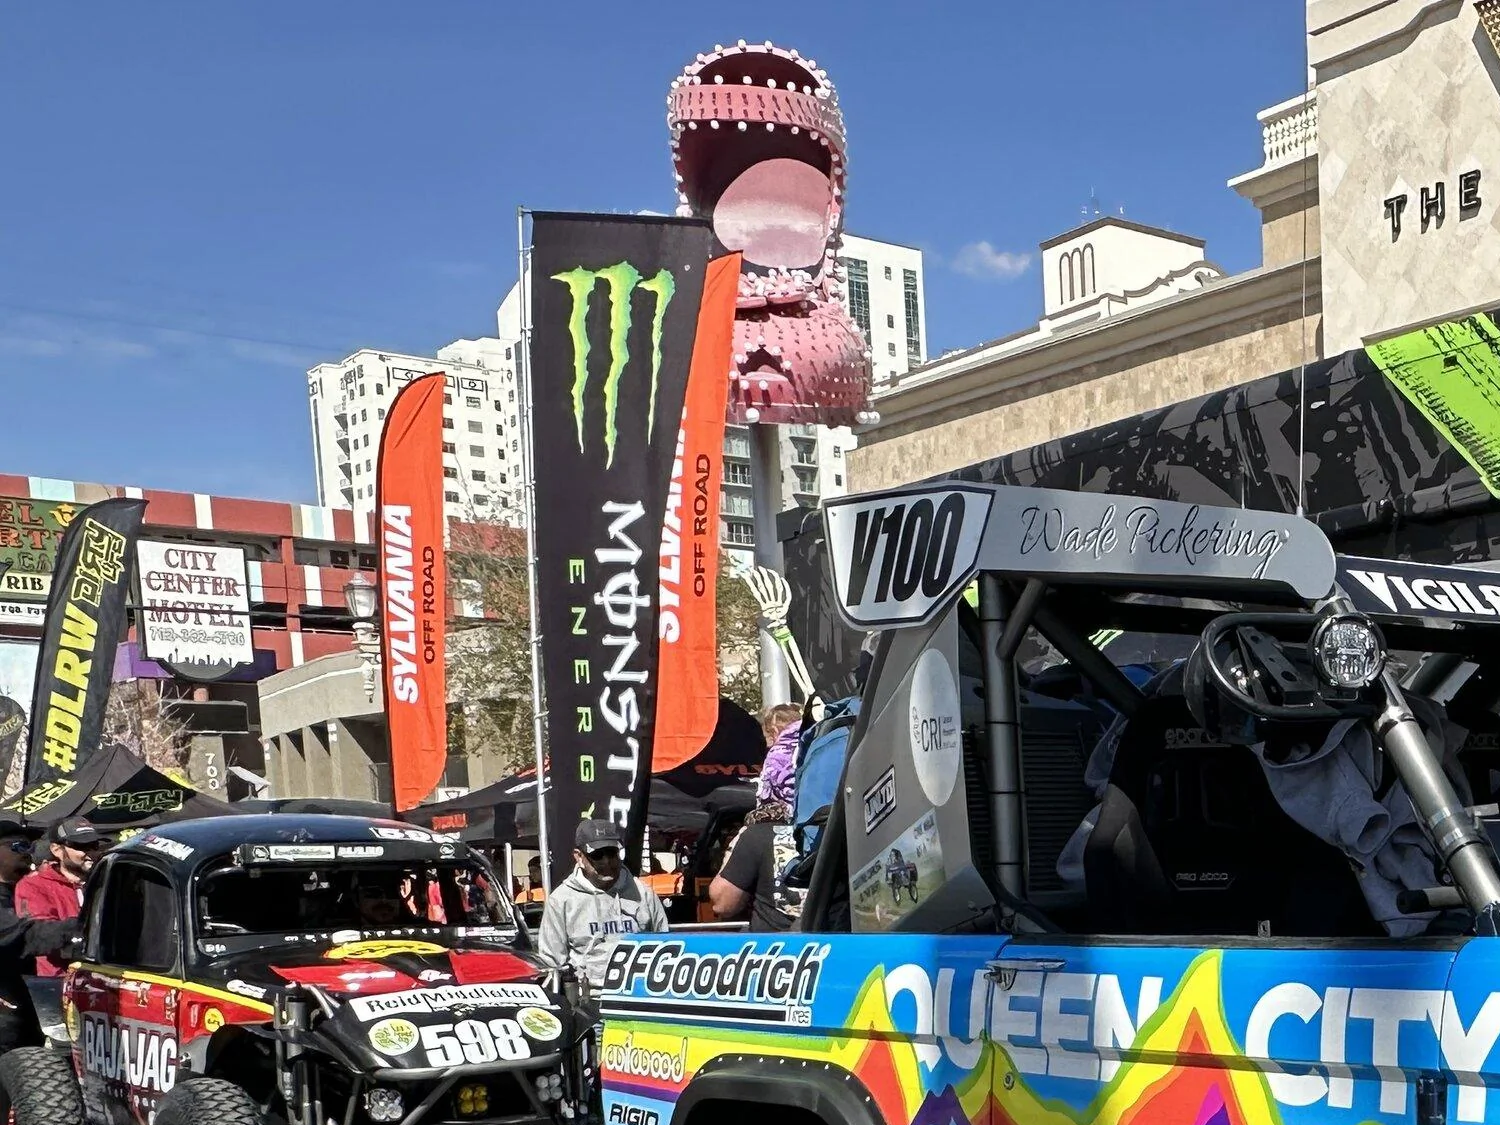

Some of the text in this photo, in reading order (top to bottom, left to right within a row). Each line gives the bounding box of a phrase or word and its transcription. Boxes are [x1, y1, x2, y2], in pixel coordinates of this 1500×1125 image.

[1384, 169, 1482, 238] THE
[164, 548, 217, 571] CITY
[693, 454, 710, 598] OFF ROAD
[846, 492, 966, 606] V100
[1020, 503, 1290, 579] Wade Pickering
[6, 576, 44, 591] RIB
[146, 571, 241, 597] CENTER
[147, 598, 244, 628] MOTEL
[383, 504, 419, 705] SYLVANIA
[423, 546, 435, 665] OFF ROAD
[43, 601, 98, 772] #DLRW
[921, 718, 943, 752] CRI
[601, 941, 824, 1003] BFGoodrich
[419, 1018, 531, 1068] 598
[887, 963, 1164, 1083] QUEEN
